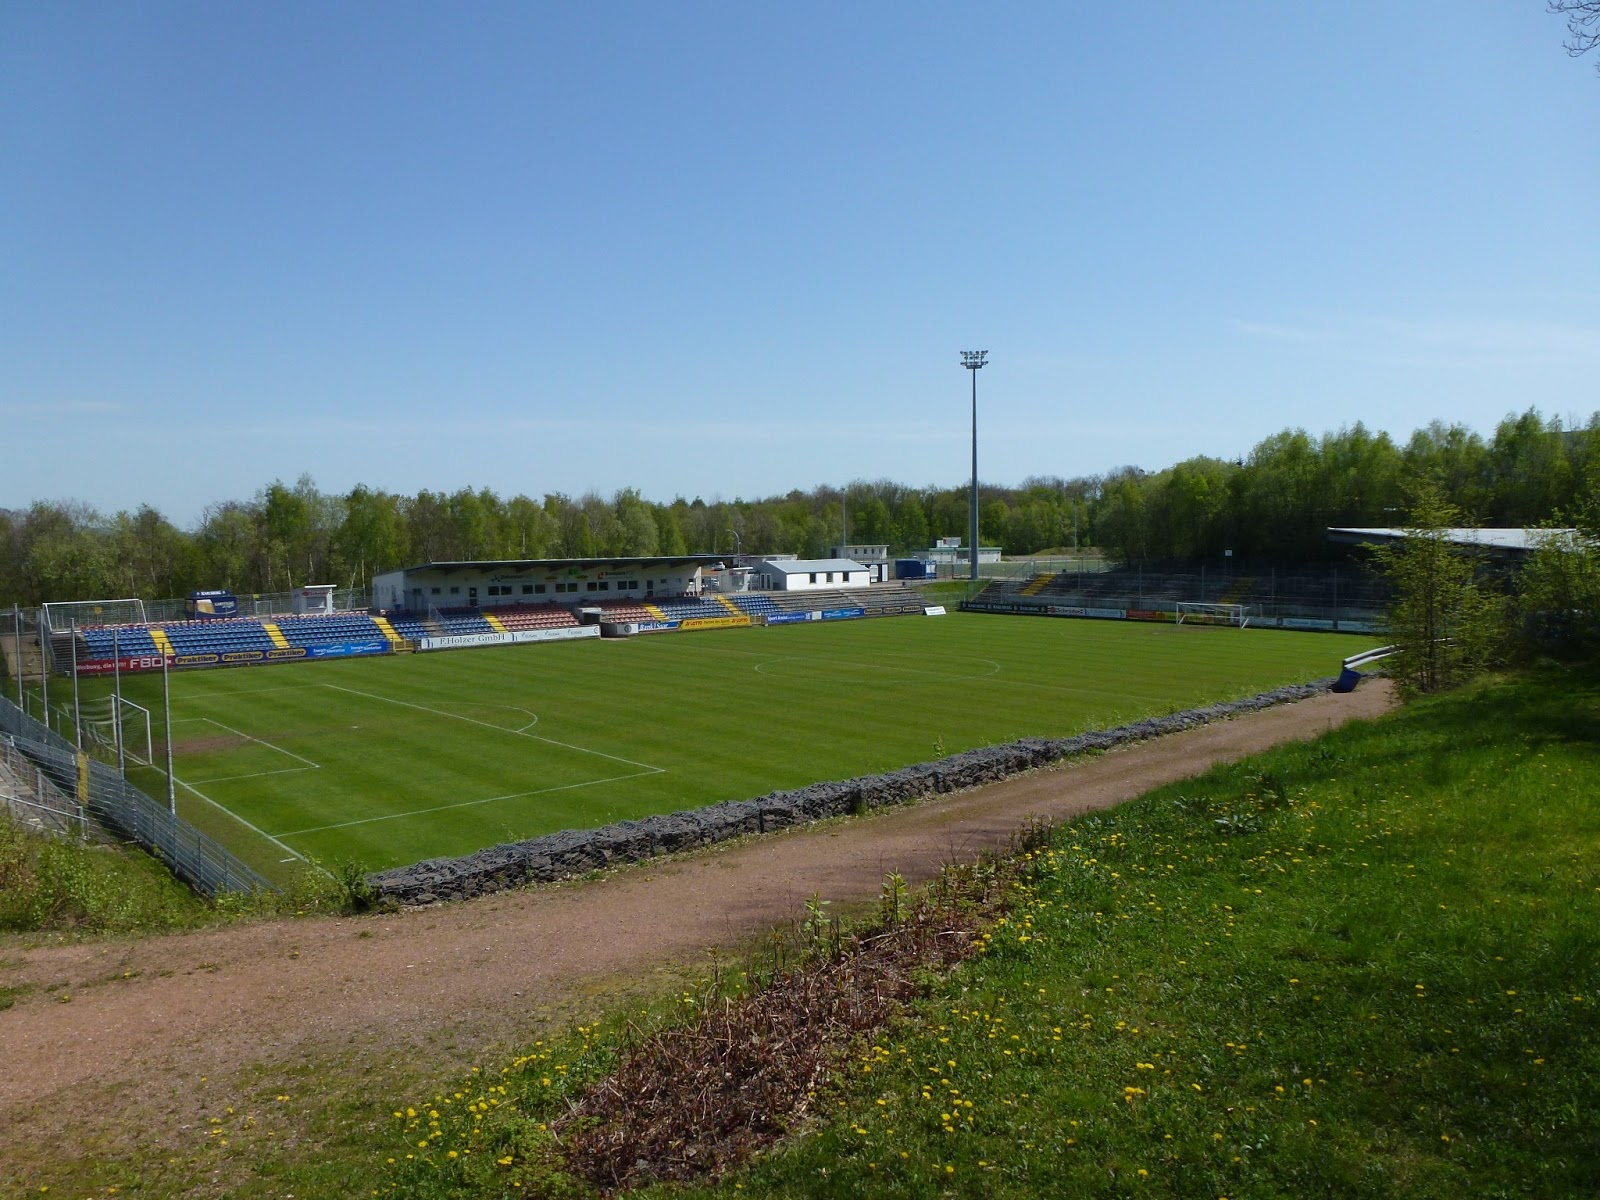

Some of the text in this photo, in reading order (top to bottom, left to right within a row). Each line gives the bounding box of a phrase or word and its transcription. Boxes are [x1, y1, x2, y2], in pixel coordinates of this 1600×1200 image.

[478, 633, 505, 642] GmbH
[223, 652, 262, 660] Praktiker
[268, 649, 305, 657] Praktiker
[177, 655, 217, 664] Praktiker
